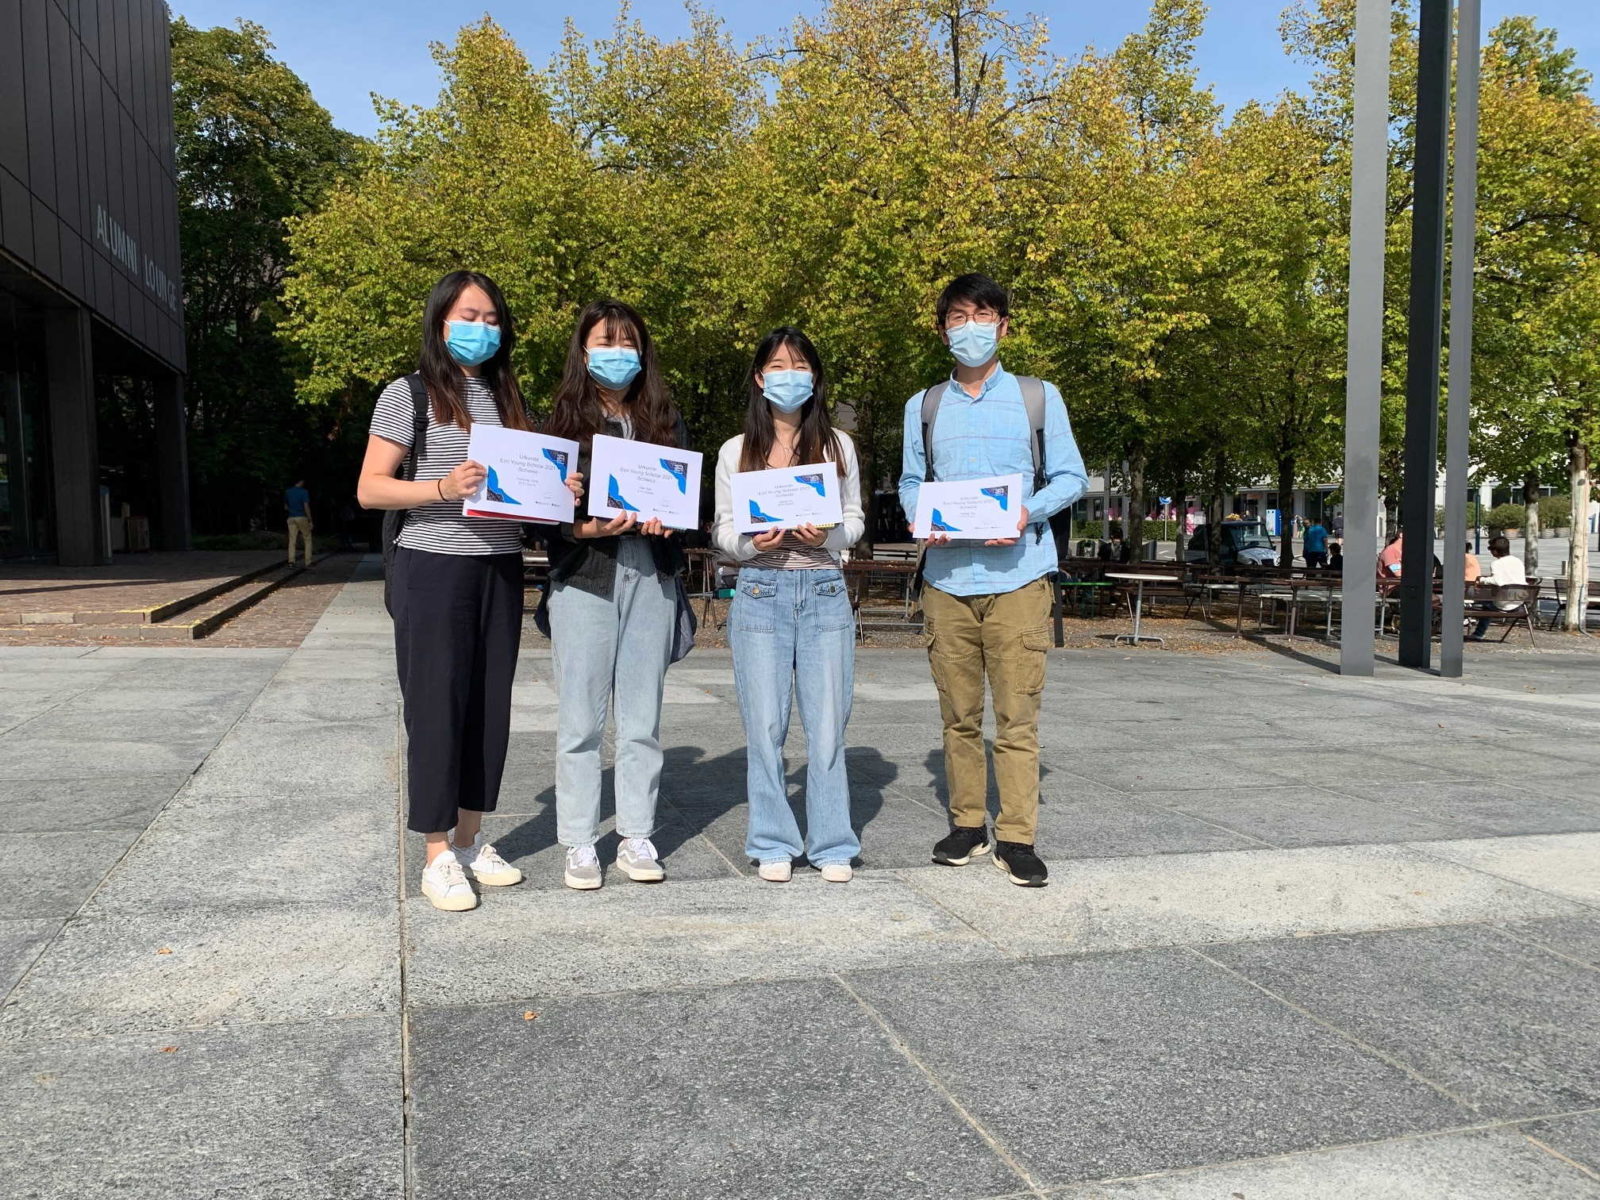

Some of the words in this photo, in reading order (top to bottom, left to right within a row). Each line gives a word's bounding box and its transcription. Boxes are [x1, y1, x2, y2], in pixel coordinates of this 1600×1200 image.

[96, 203, 138, 277] ALUMNI
[144, 253, 177, 312] LOUNGE
[511, 459, 526, 467] Young
[630, 468, 645, 476] Young
